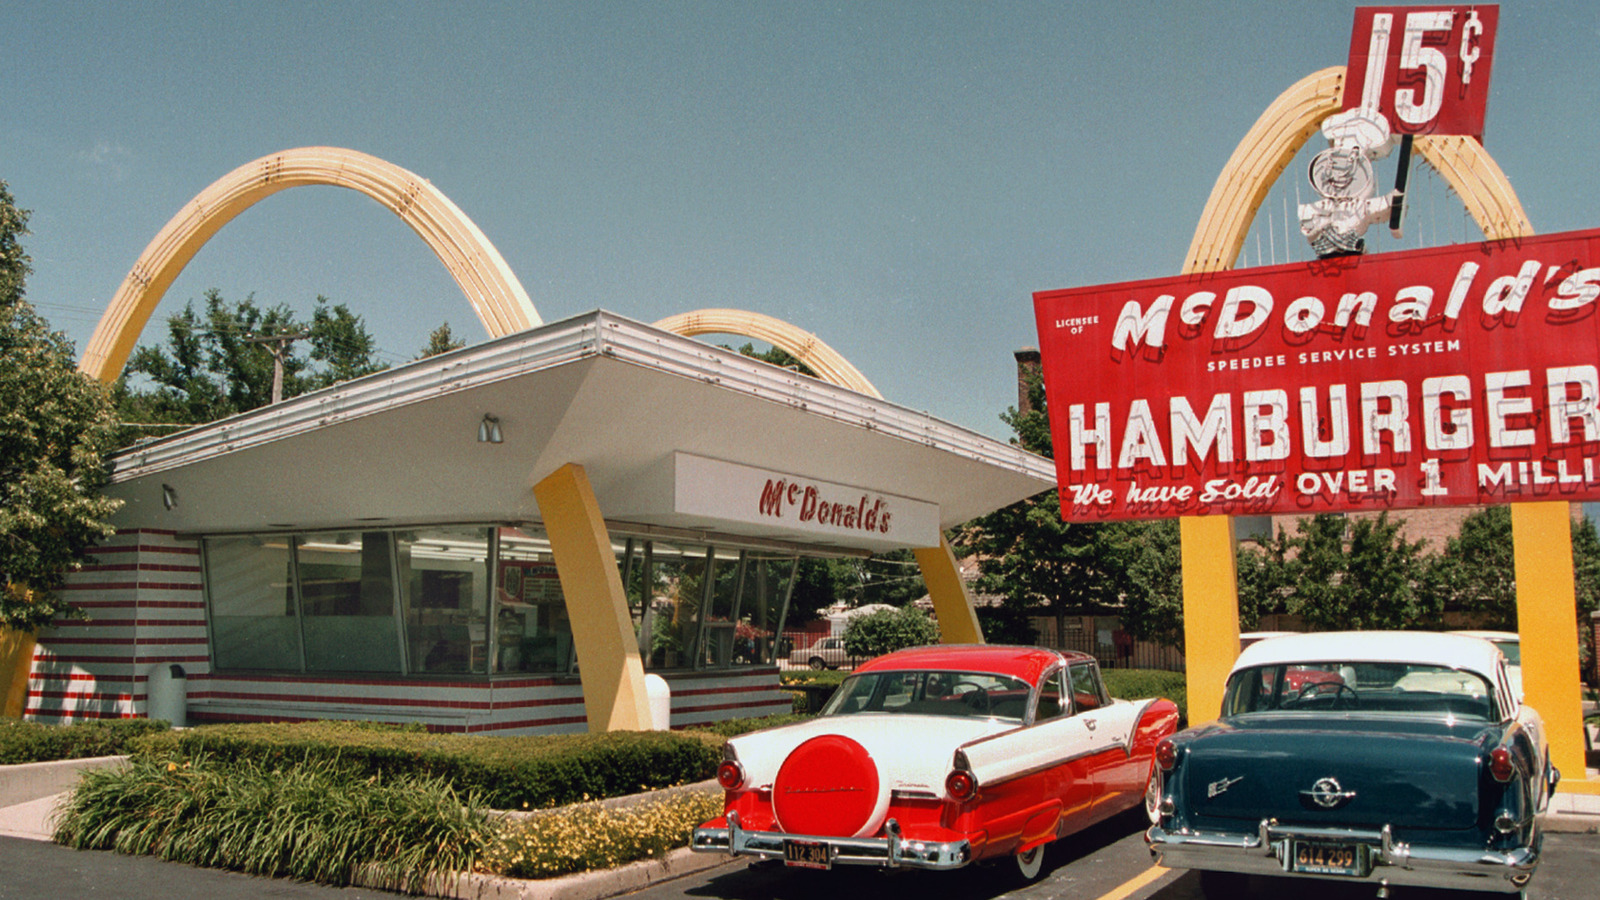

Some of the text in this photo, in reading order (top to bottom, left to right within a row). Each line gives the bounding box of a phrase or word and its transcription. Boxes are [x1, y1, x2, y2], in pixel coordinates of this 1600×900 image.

[1112, 260, 1600, 350] McDonald's
[1056, 316, 1098, 327] LICENSEE
[1071, 326, 1082, 334] OF
[1208, 340, 1459, 371] SPEEDEE SERVICE SYSTEM
[1069, 365, 1600, 470] HAMBURGER
[1069, 484, 1112, 505] We
[1126, 481, 1193, 503] have
[1199, 475, 1279, 502] Sold
[1297, 469, 1396, 494] OVER
[1421, 459, 1448, 496] 1
[759, 479, 891, 533] McDonald's
[788, 844, 827, 863] 112 304
[1299, 848, 1353, 867] 614 299
